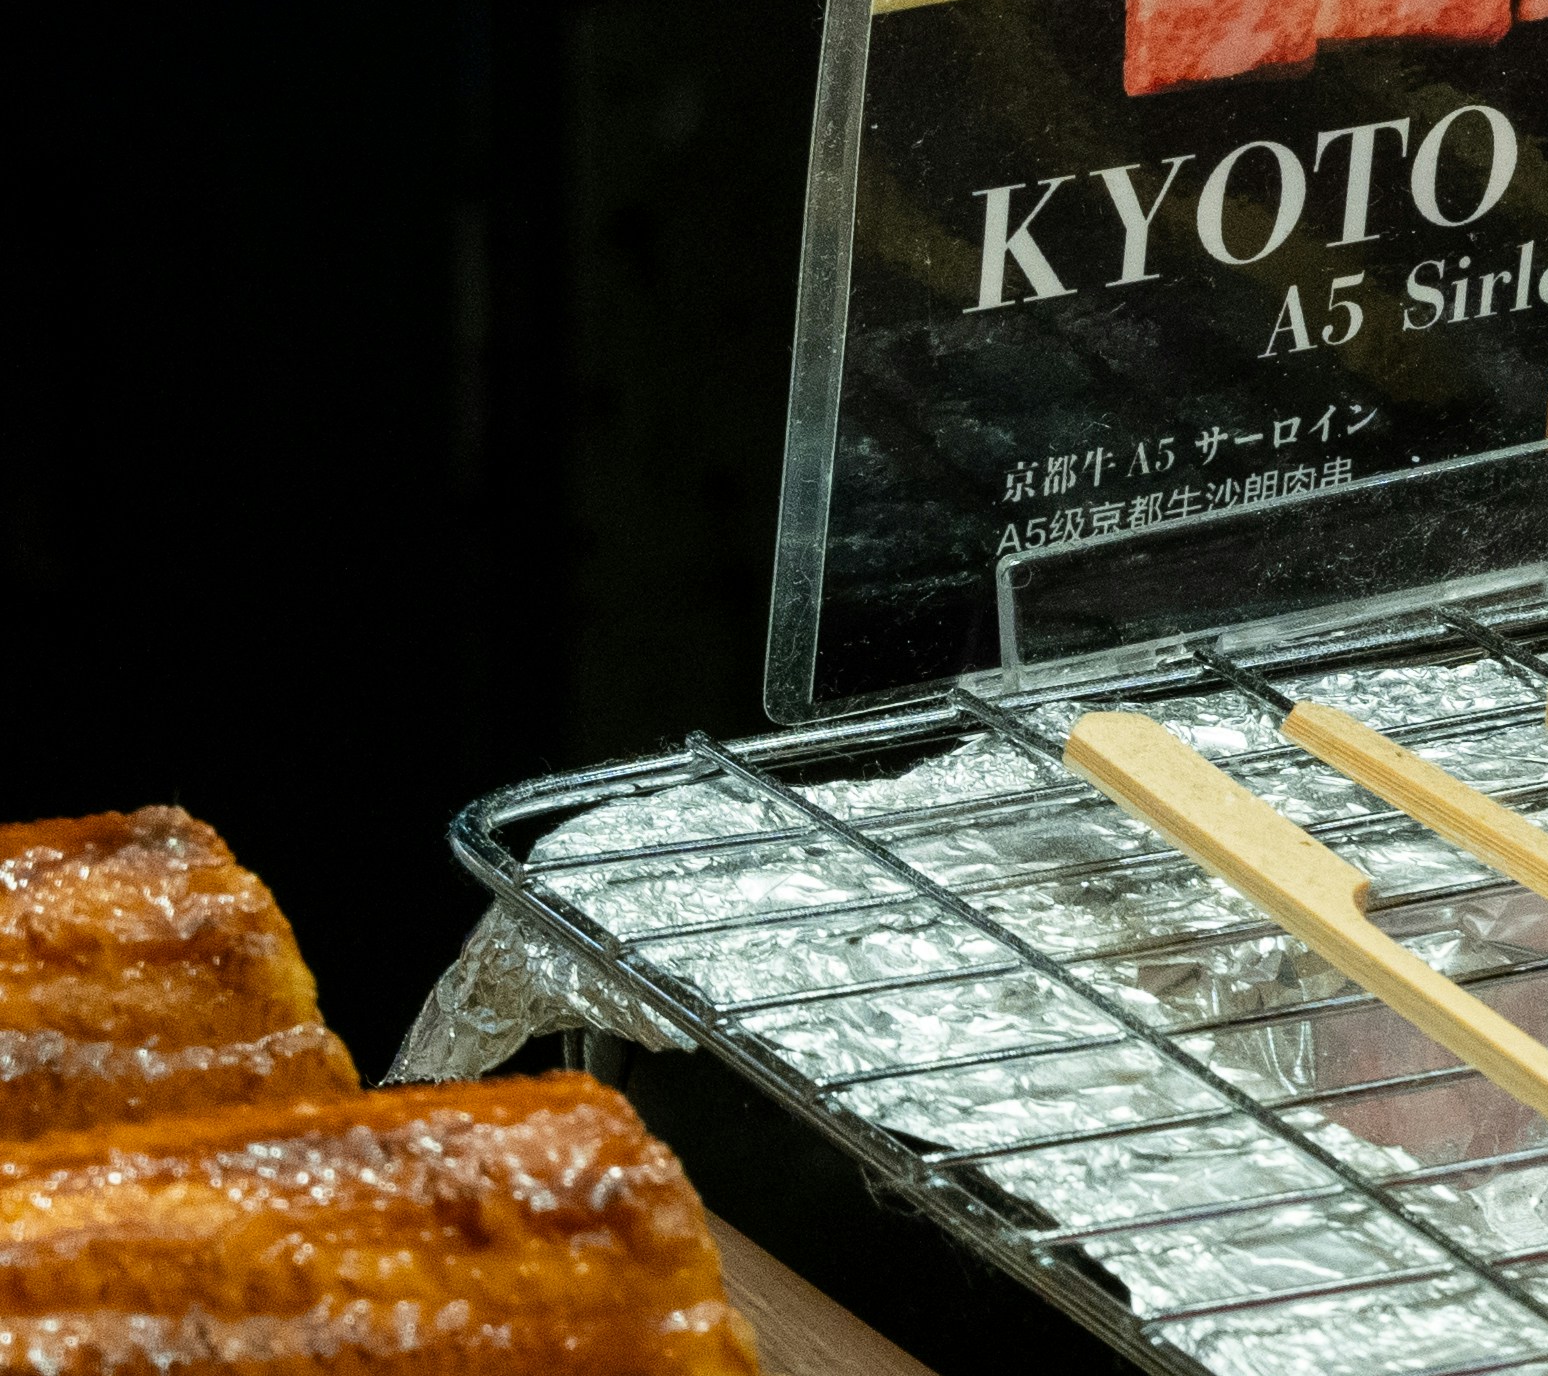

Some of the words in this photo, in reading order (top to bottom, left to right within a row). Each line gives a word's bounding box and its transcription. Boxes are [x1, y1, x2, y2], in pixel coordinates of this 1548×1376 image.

[962, 105, 1519, 314] KYOTO
[1256, 270, 1366, 359] A5
[1001, 446, 1117, 505] 京都牛
[1126, 437, 1177, 479] A5
[1194, 404, 1379, 467] サーロイン
